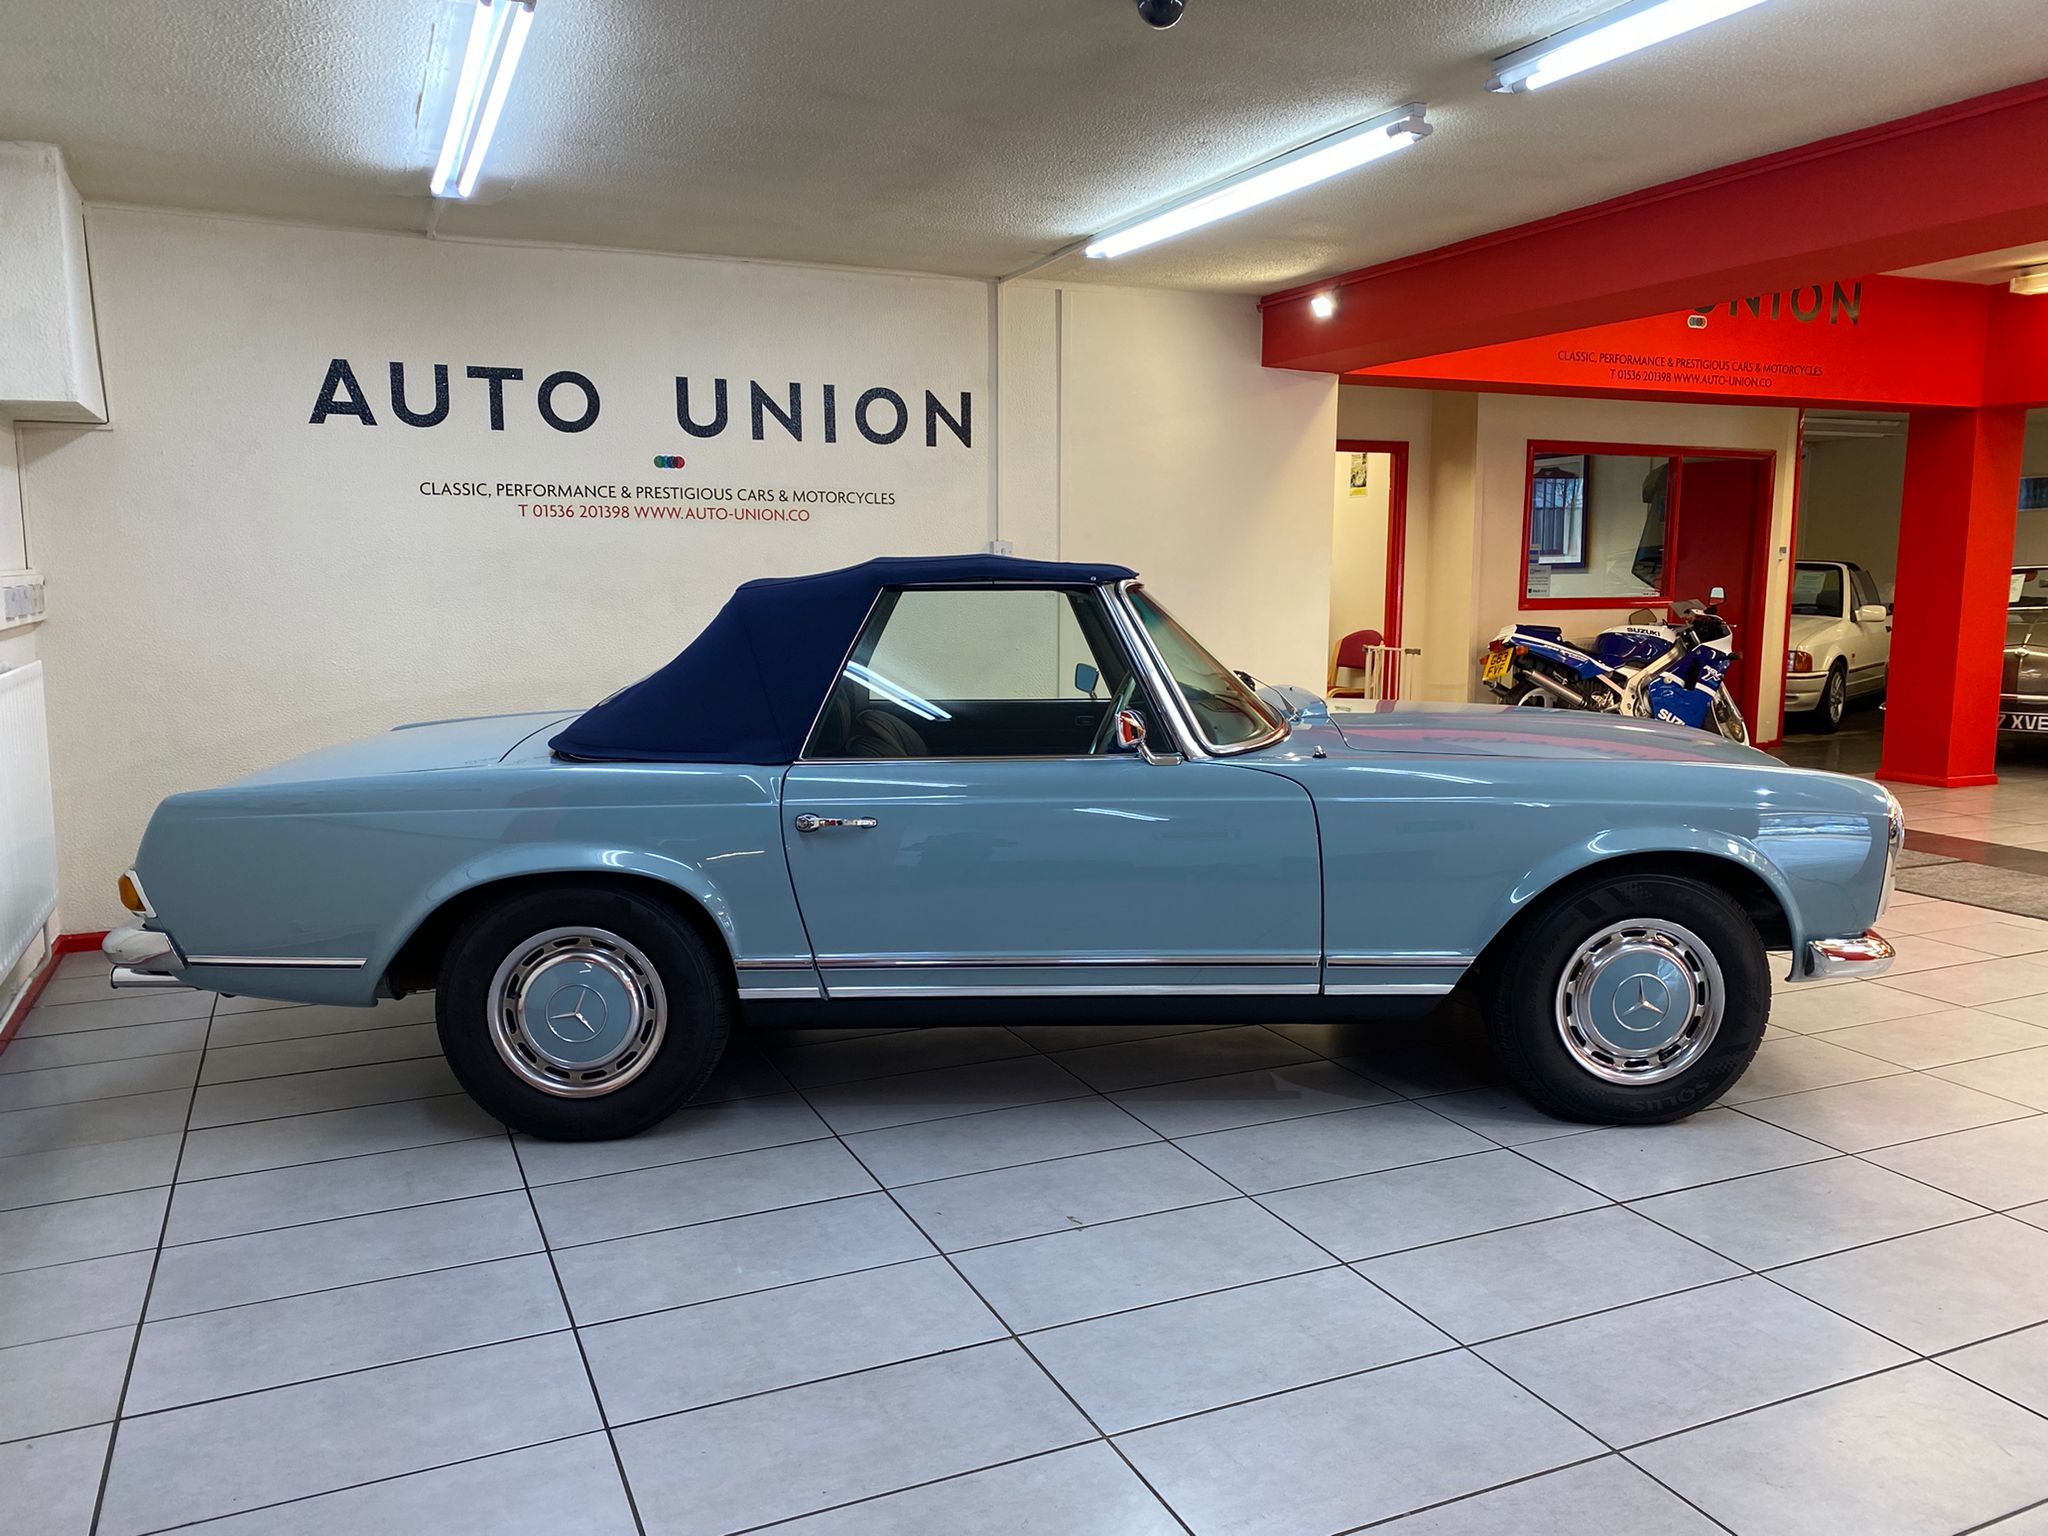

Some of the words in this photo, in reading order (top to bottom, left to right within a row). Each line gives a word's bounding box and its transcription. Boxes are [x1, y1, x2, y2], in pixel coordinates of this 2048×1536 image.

[1694, 281, 1862, 326] NION
[1600, 353, 1665, 367] PERFORMANCE
[1667, 357, 1674, 367] &
[1675, 357, 1729, 371] PRESTIGIOUS
[1731, 361, 1753, 372] CARS
[1754, 363, 1761, 372] &
[1763, 363, 1823, 377] MOTORCYCLES
[1610, 368, 1616, 379] T
[1617, 369, 1641, 381] 01536
[1643, 371, 1671, 382] 201398
[1673, 373, 1772, 388] WWW.AUTO-UNION.CO
[308, 358, 601, 434] AUTO
[675, 375, 973, 449] UNION
[419, 481, 492, 498] CLASSIC,
[496, 483, 616, 499] PERFORMANCE
[621, 485, 632, 499] &
[636, 486, 733, 501] PRESTIGIOUS
[737, 488, 775, 502] CARS
[778, 489, 789, 502] &
[793, 490, 896, 505] MOTORCYCLES
[518, 504, 528, 517] T
[533, 504, 575, 518] 01536
[579, 505, 630, 519] 201398
[634, 505, 810, 522] WWW.AUTO-UNION.CO
[1626, 627, 1661, 637] SUZUKI
[1657, 708, 1686, 726] SUZ
[1629, 1079, 1710, 1113] SOLUS
